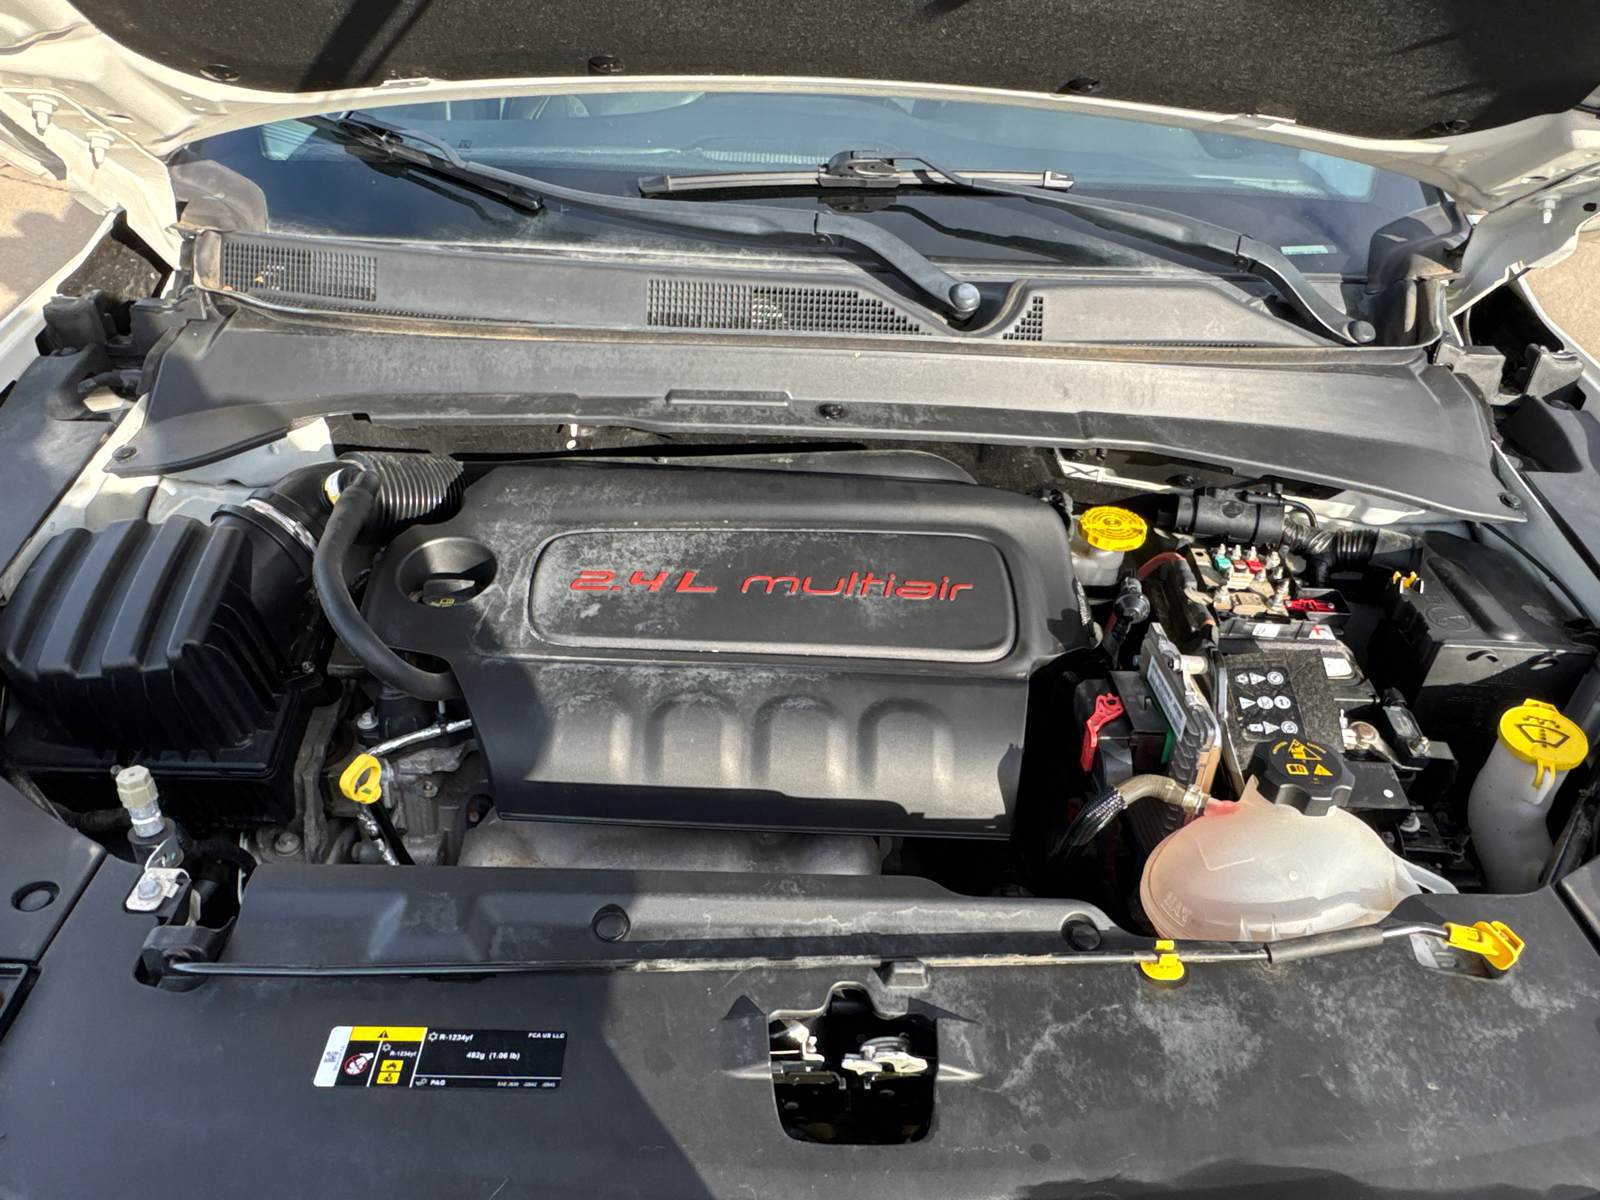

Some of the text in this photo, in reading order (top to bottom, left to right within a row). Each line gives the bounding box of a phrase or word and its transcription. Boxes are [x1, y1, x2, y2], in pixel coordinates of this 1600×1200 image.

[569, 570, 974, 602] 2.4L multiair
[1164, 890, 1193, 923] MAX
[438, 1033, 474, 1043] R-1234yf
[389, 1050, 417, 1058] R-1234yf
[488, 1051, 508, 1061] (1.06
[509, 1051, 521, 1061] lb)
[429, 1079, 446, 1087] PAG
